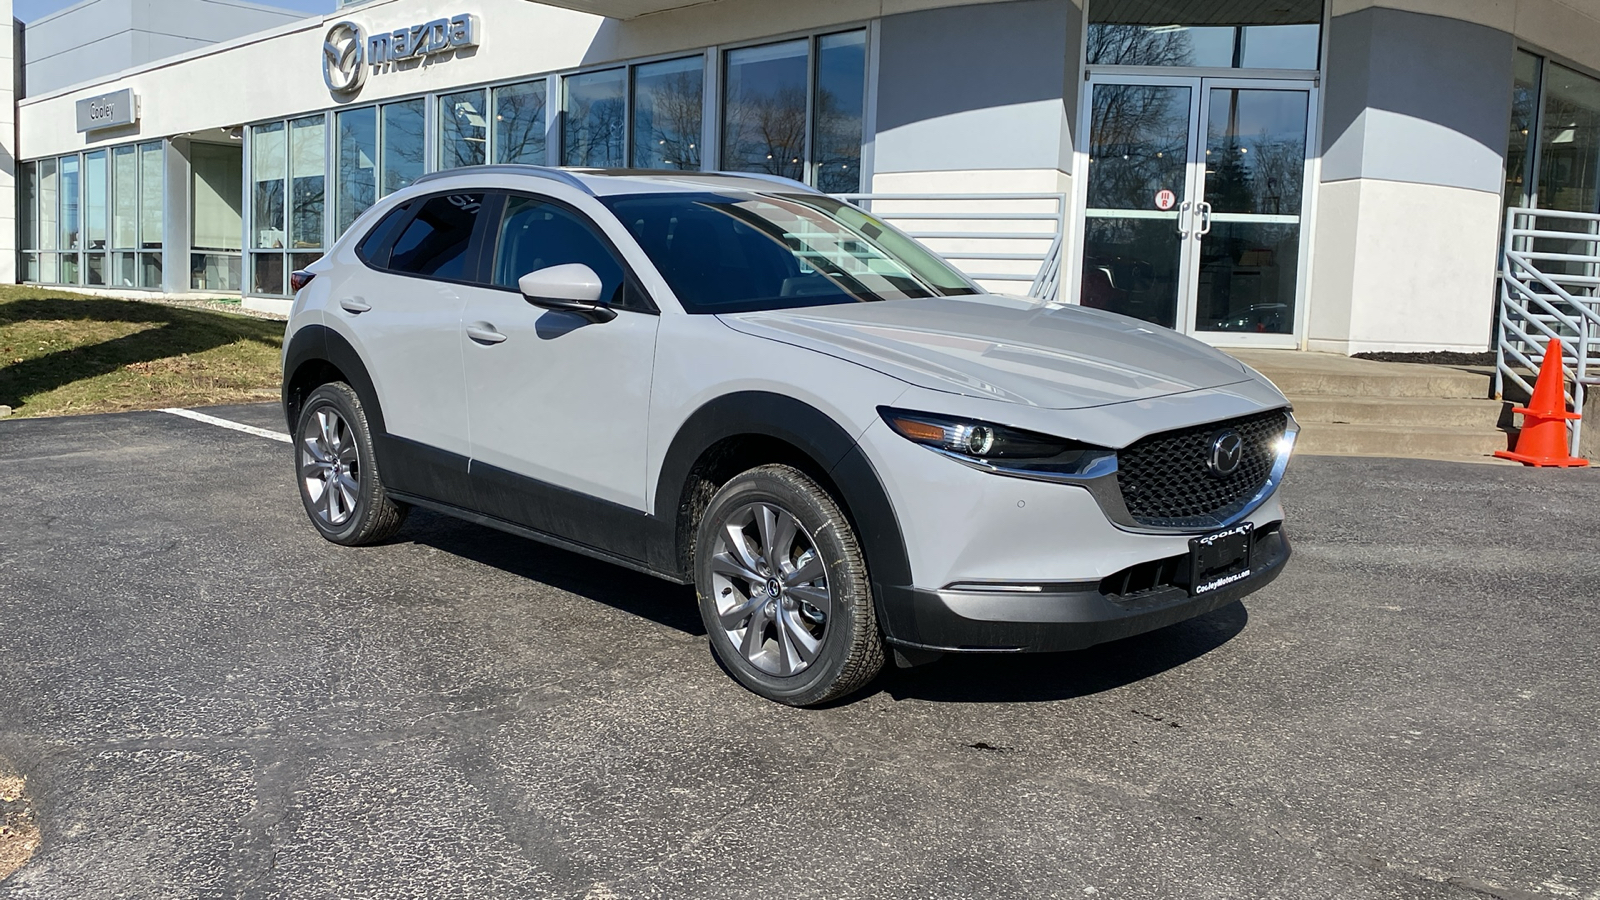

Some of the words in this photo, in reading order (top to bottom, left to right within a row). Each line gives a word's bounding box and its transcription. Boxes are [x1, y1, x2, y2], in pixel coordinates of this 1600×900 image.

[90, 98, 115, 122] Cooley
[1161, 199, 1169, 207] R
[1199, 523, 1253, 544] COOLEY
[1195, 569, 1251, 594] CooleyMotors.com
